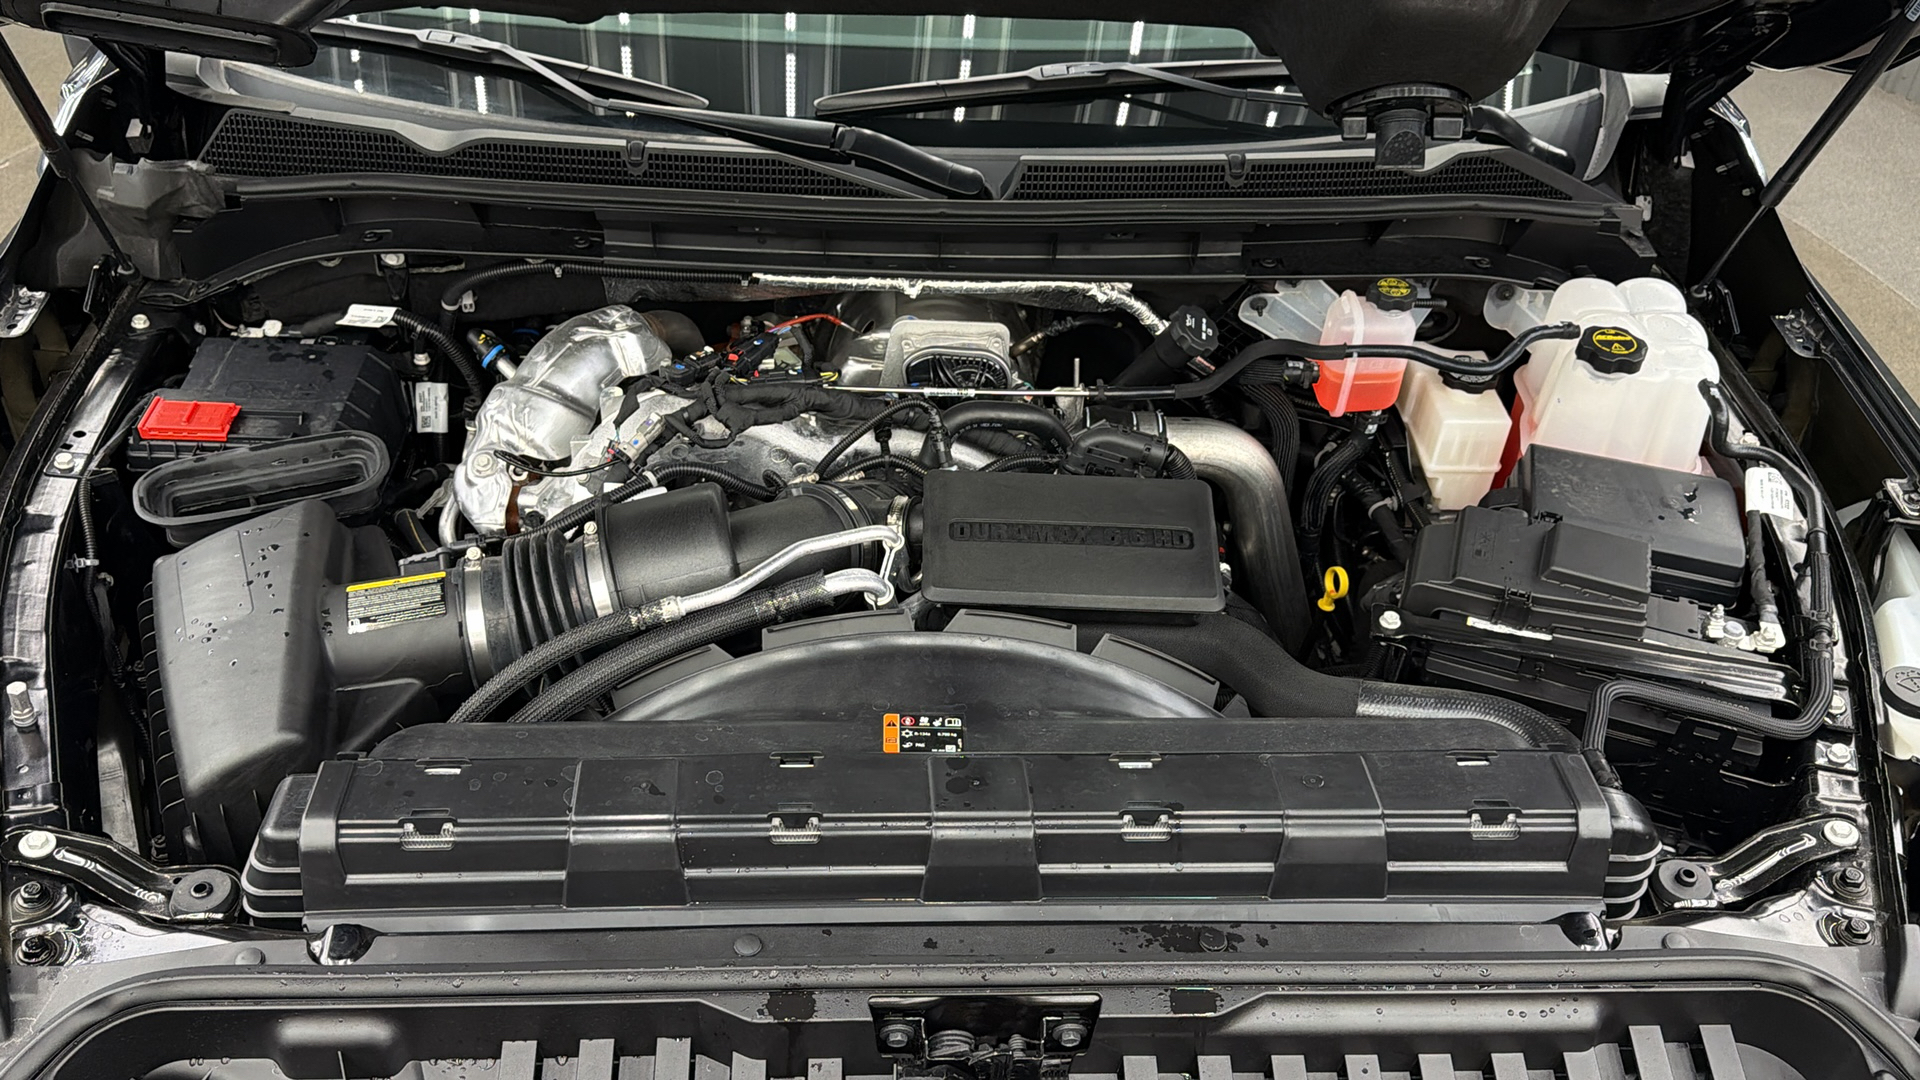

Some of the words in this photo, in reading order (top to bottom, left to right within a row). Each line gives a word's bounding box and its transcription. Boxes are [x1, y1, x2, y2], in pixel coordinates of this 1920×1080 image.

[953, 521, 1090, 544] DURAMAX
[1103, 526, 1148, 546] 6.6
[1154, 528, 1191, 549] HD
